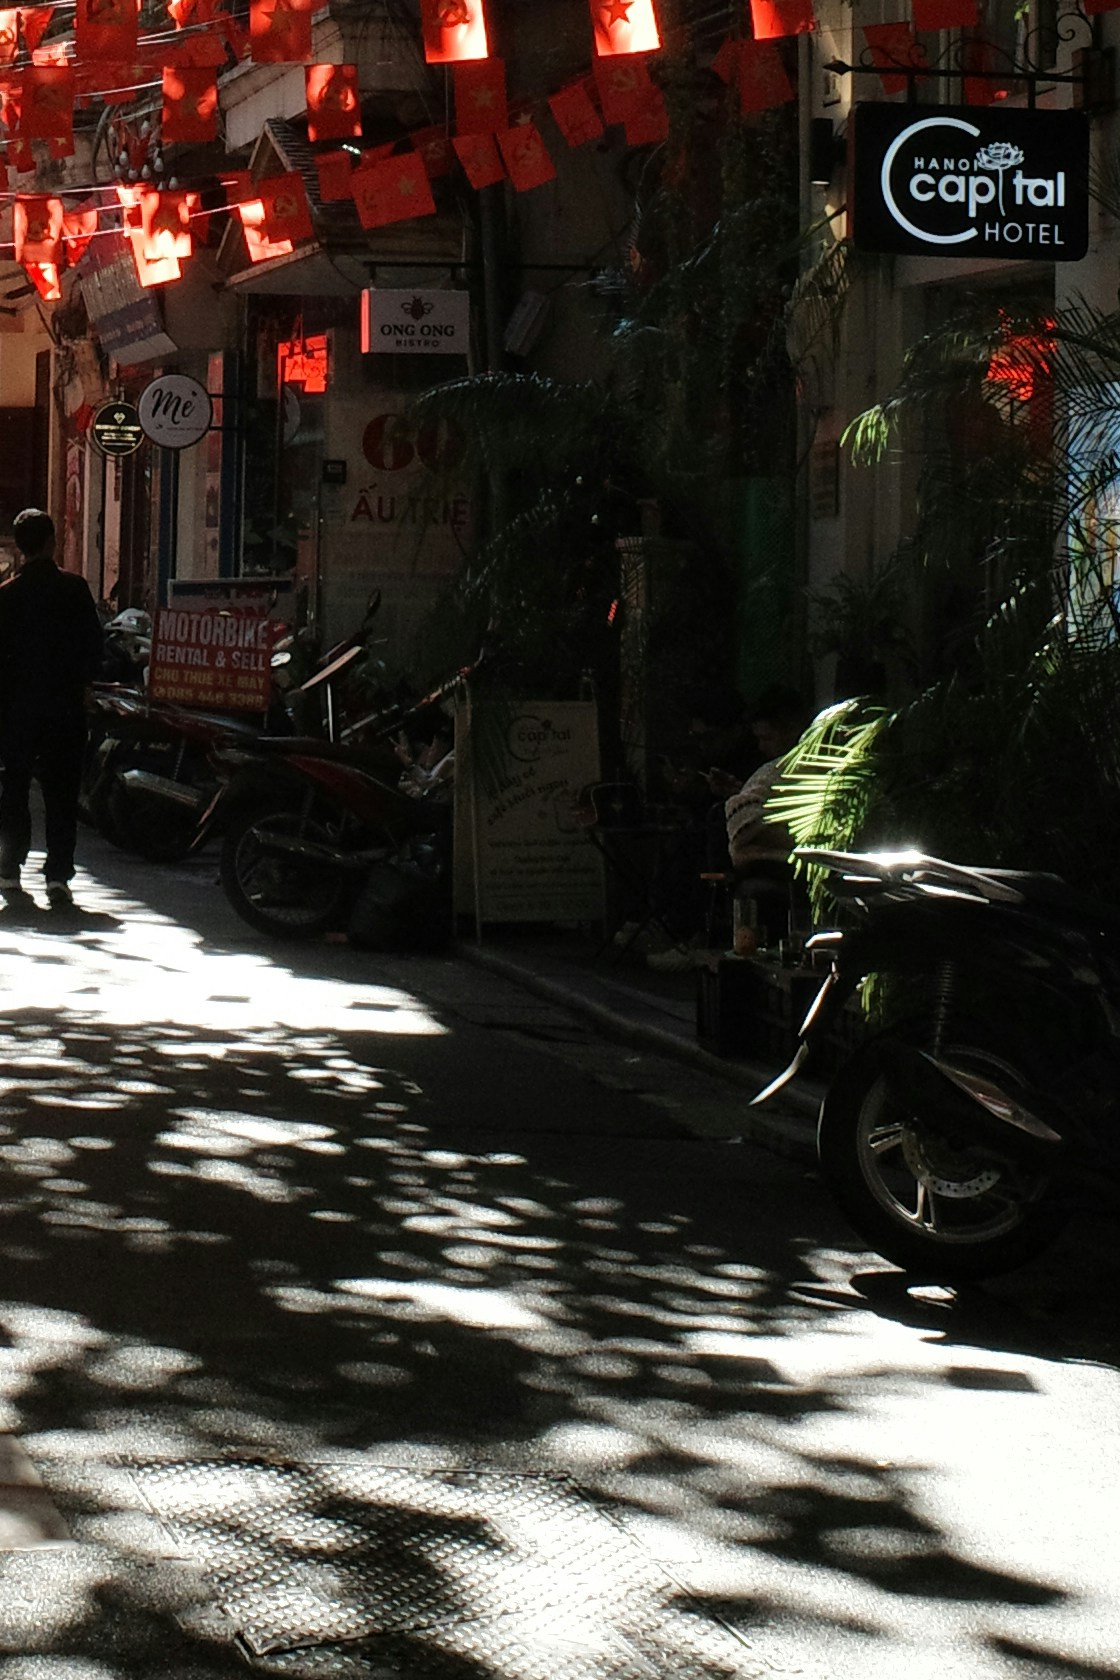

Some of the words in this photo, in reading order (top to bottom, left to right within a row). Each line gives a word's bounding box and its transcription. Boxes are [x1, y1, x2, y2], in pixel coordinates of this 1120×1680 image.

[913, 156, 979, 171] HANOI
[984, 221, 1065, 245] HOTEL
[380, 324, 415, 336] ONG
[420, 325, 455, 337] ONG
[395, 339, 440, 348] BISTRO
[351, 483, 396, 523] ẤU
[159, 611, 269, 650] MOTORBIKE
[156, 644, 210, 667] RENTAL
[215, 650, 226, 668] &
[231, 650, 266, 671] SELL
